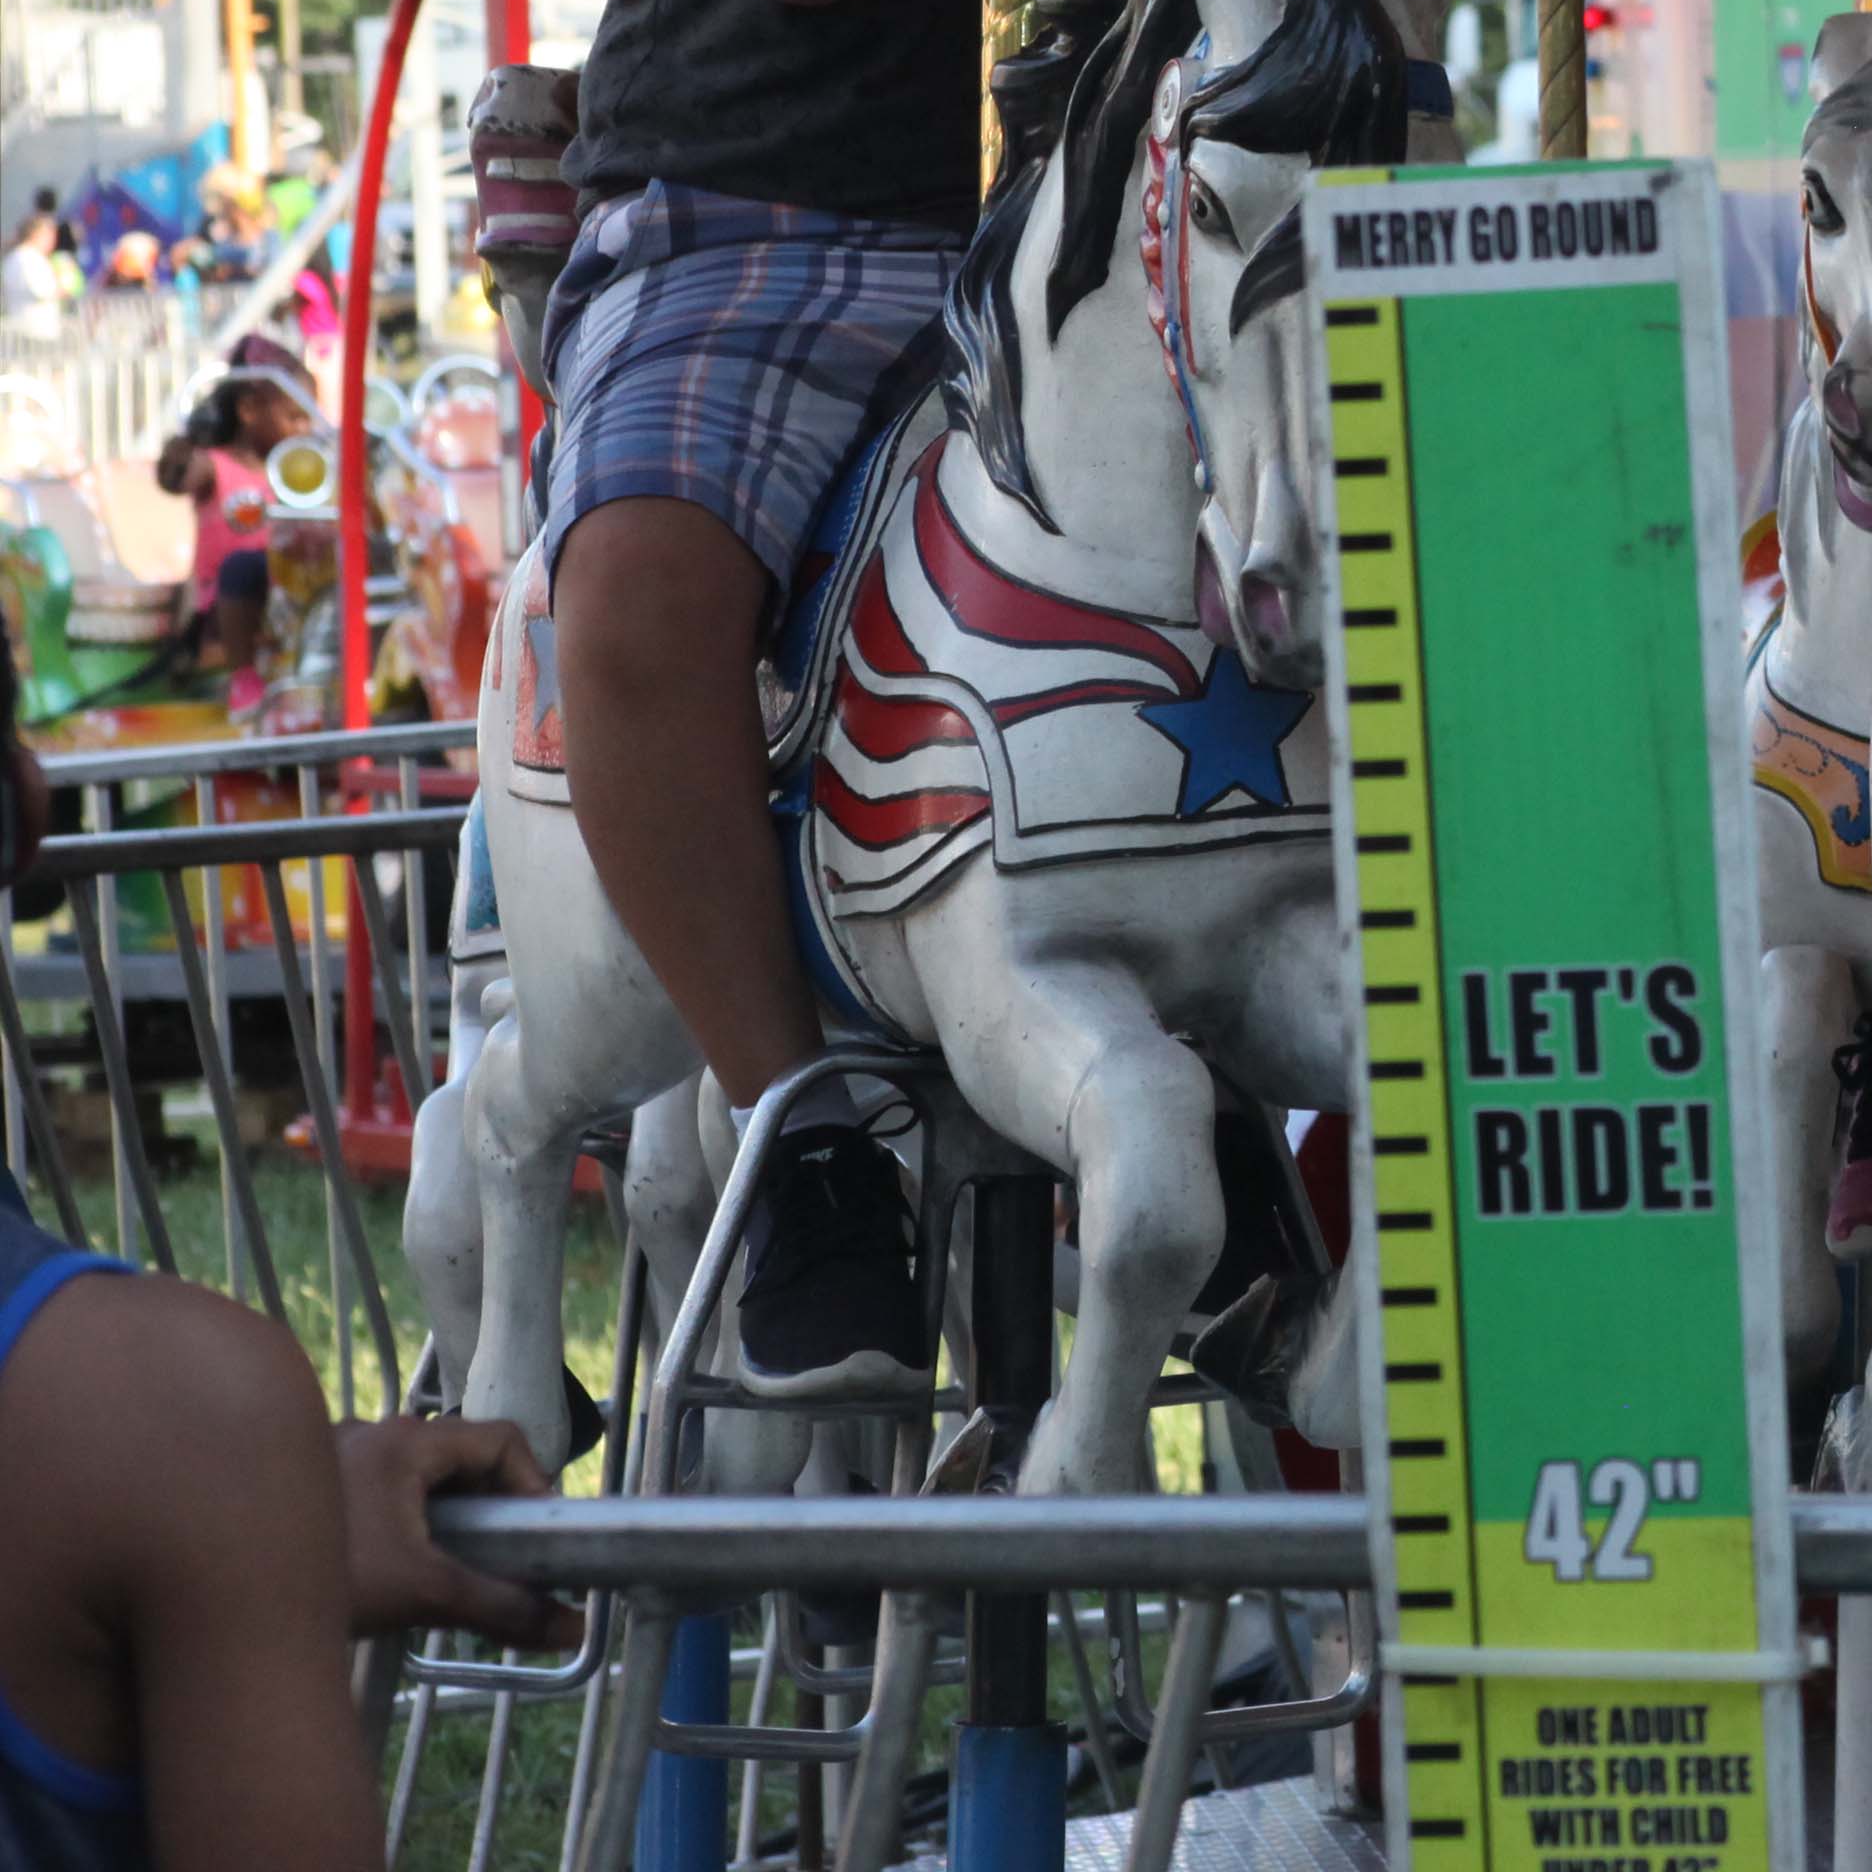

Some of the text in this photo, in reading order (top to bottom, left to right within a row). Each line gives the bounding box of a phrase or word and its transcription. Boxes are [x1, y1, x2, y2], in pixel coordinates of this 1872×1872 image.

[1333, 197, 1659, 270] MERRY GO ROUND
[1462, 964, 1703, 1079] LET'S
[1472, 1102, 1715, 1217] RIDE!
[1523, 1458, 1701, 1583] 42"
[1537, 1704, 1709, 1746] ONE ADULT
[1500, 1755, 1752, 1798] RIDES FOR FREE
[1530, 1806, 1729, 1848] WITH CHILD
